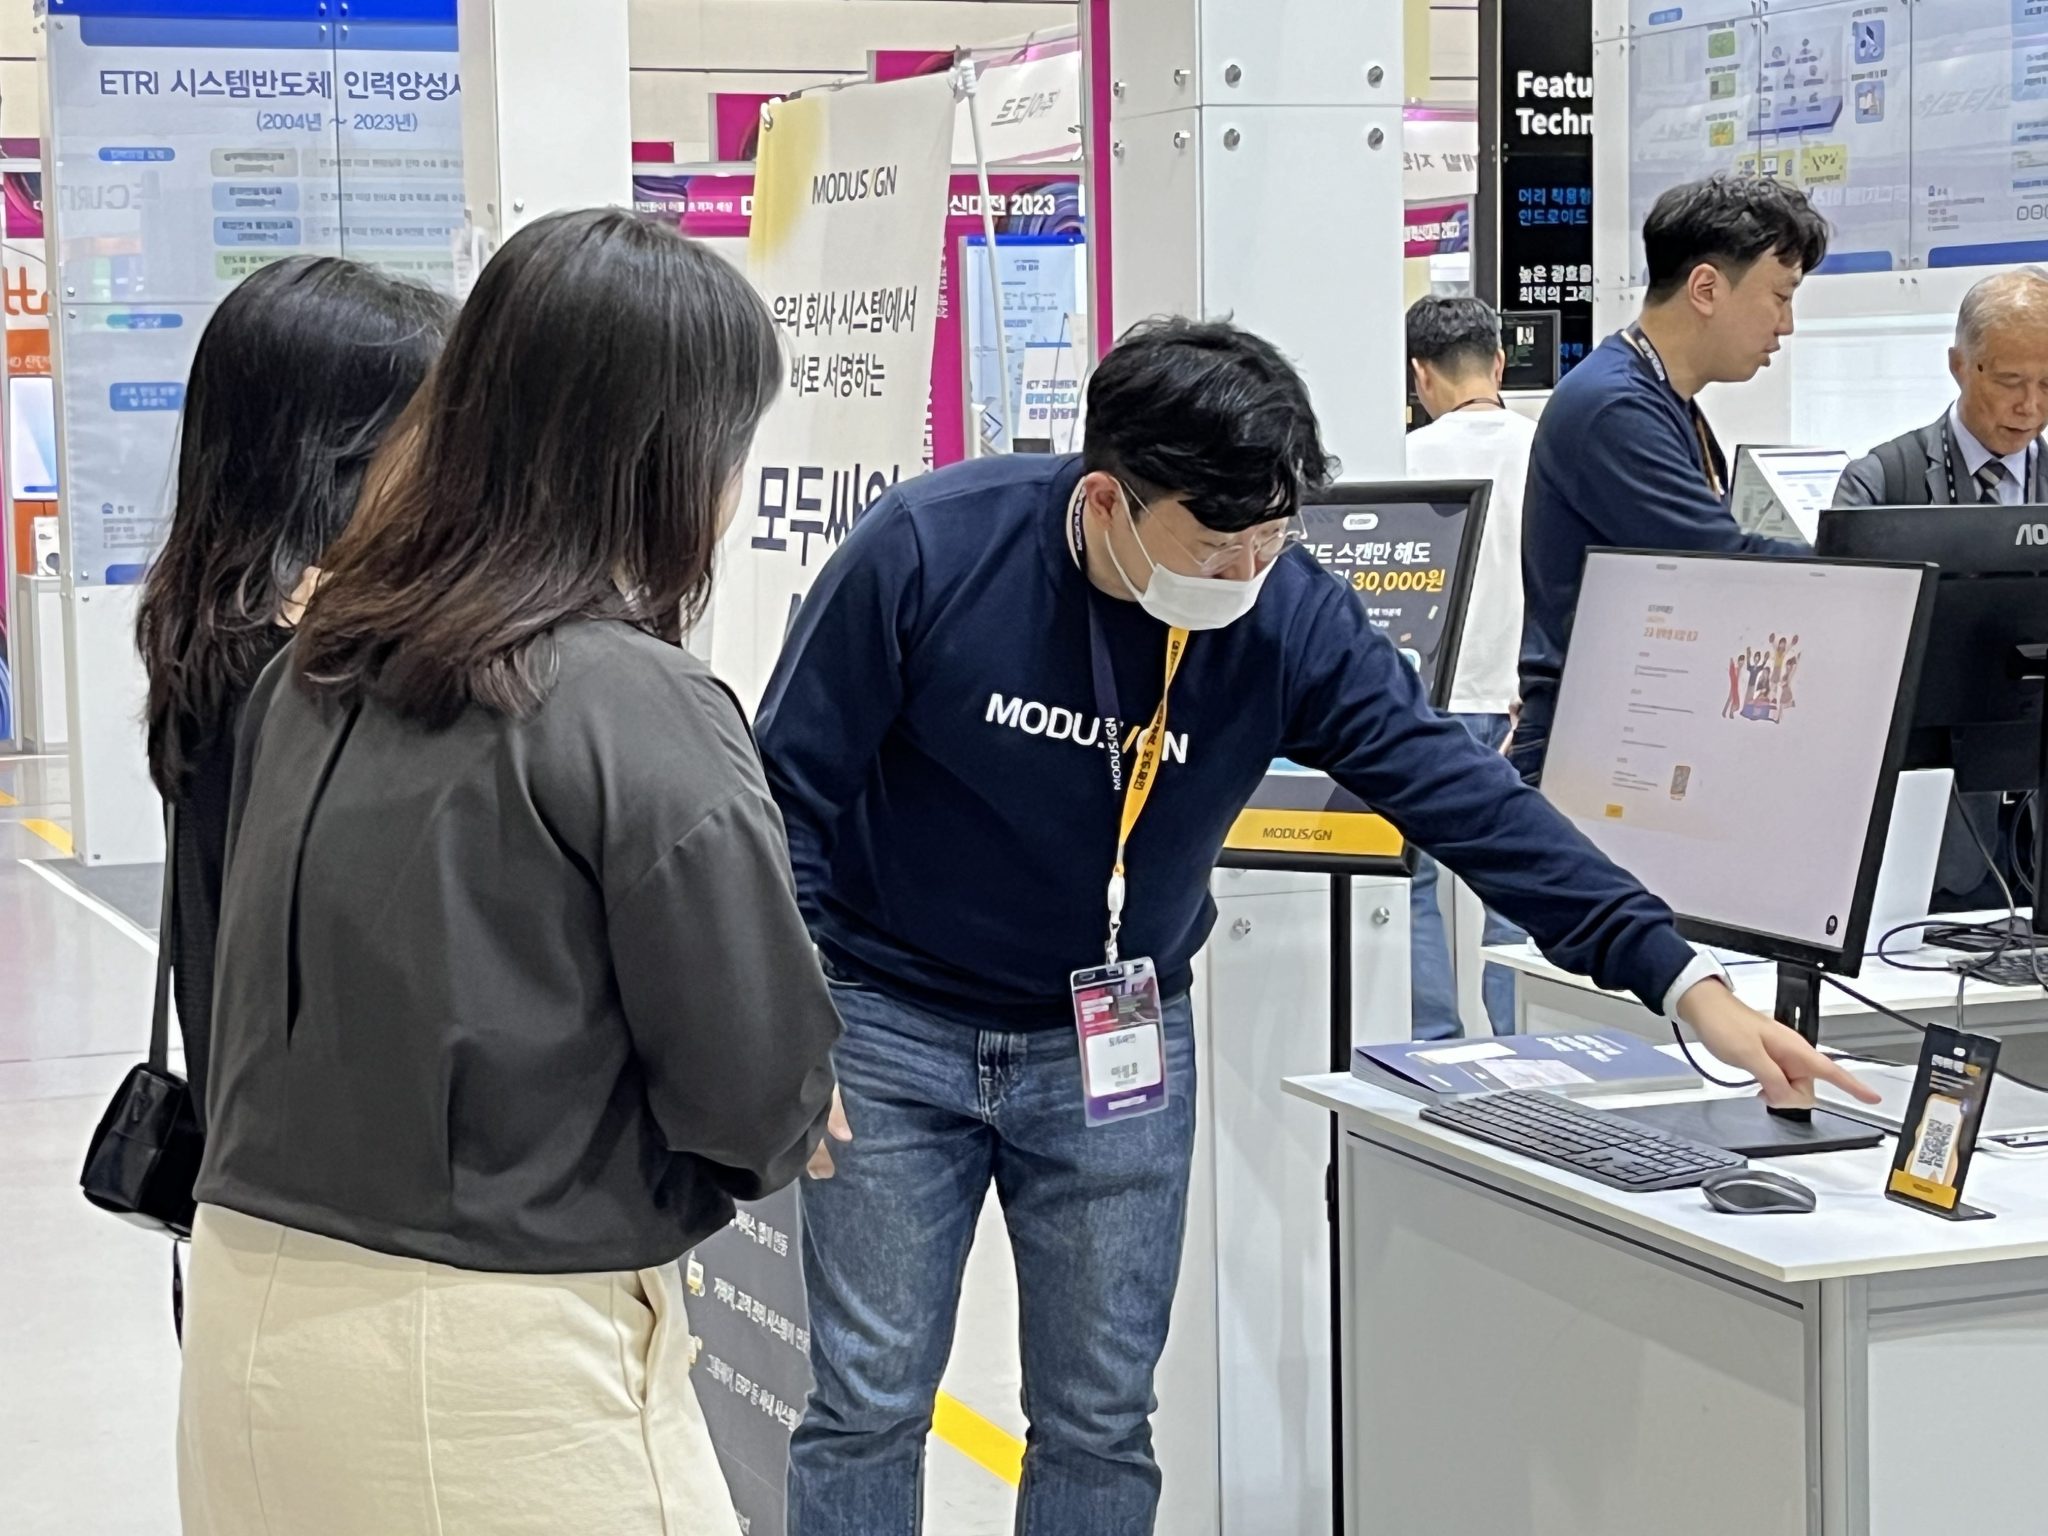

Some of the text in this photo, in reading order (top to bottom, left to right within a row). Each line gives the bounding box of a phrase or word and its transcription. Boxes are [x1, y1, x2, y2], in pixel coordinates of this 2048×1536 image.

[100, 70, 160, 95] ETRI
[171, 69, 333, 100] 시스템반도체
[256, 110, 322, 132] (2004년
[354, 113, 418, 132] 2023년)
[1011, 193, 1055, 216] 2023
[773, 285, 917, 338] 우리 회사 시스템에서
[790, 352, 885, 398] 바로 서명하는
[1335, 541, 1392, 565] 스캔만
[1394, 541, 1432, 565] 해도
[1352, 568, 1446, 596] 30,000원
